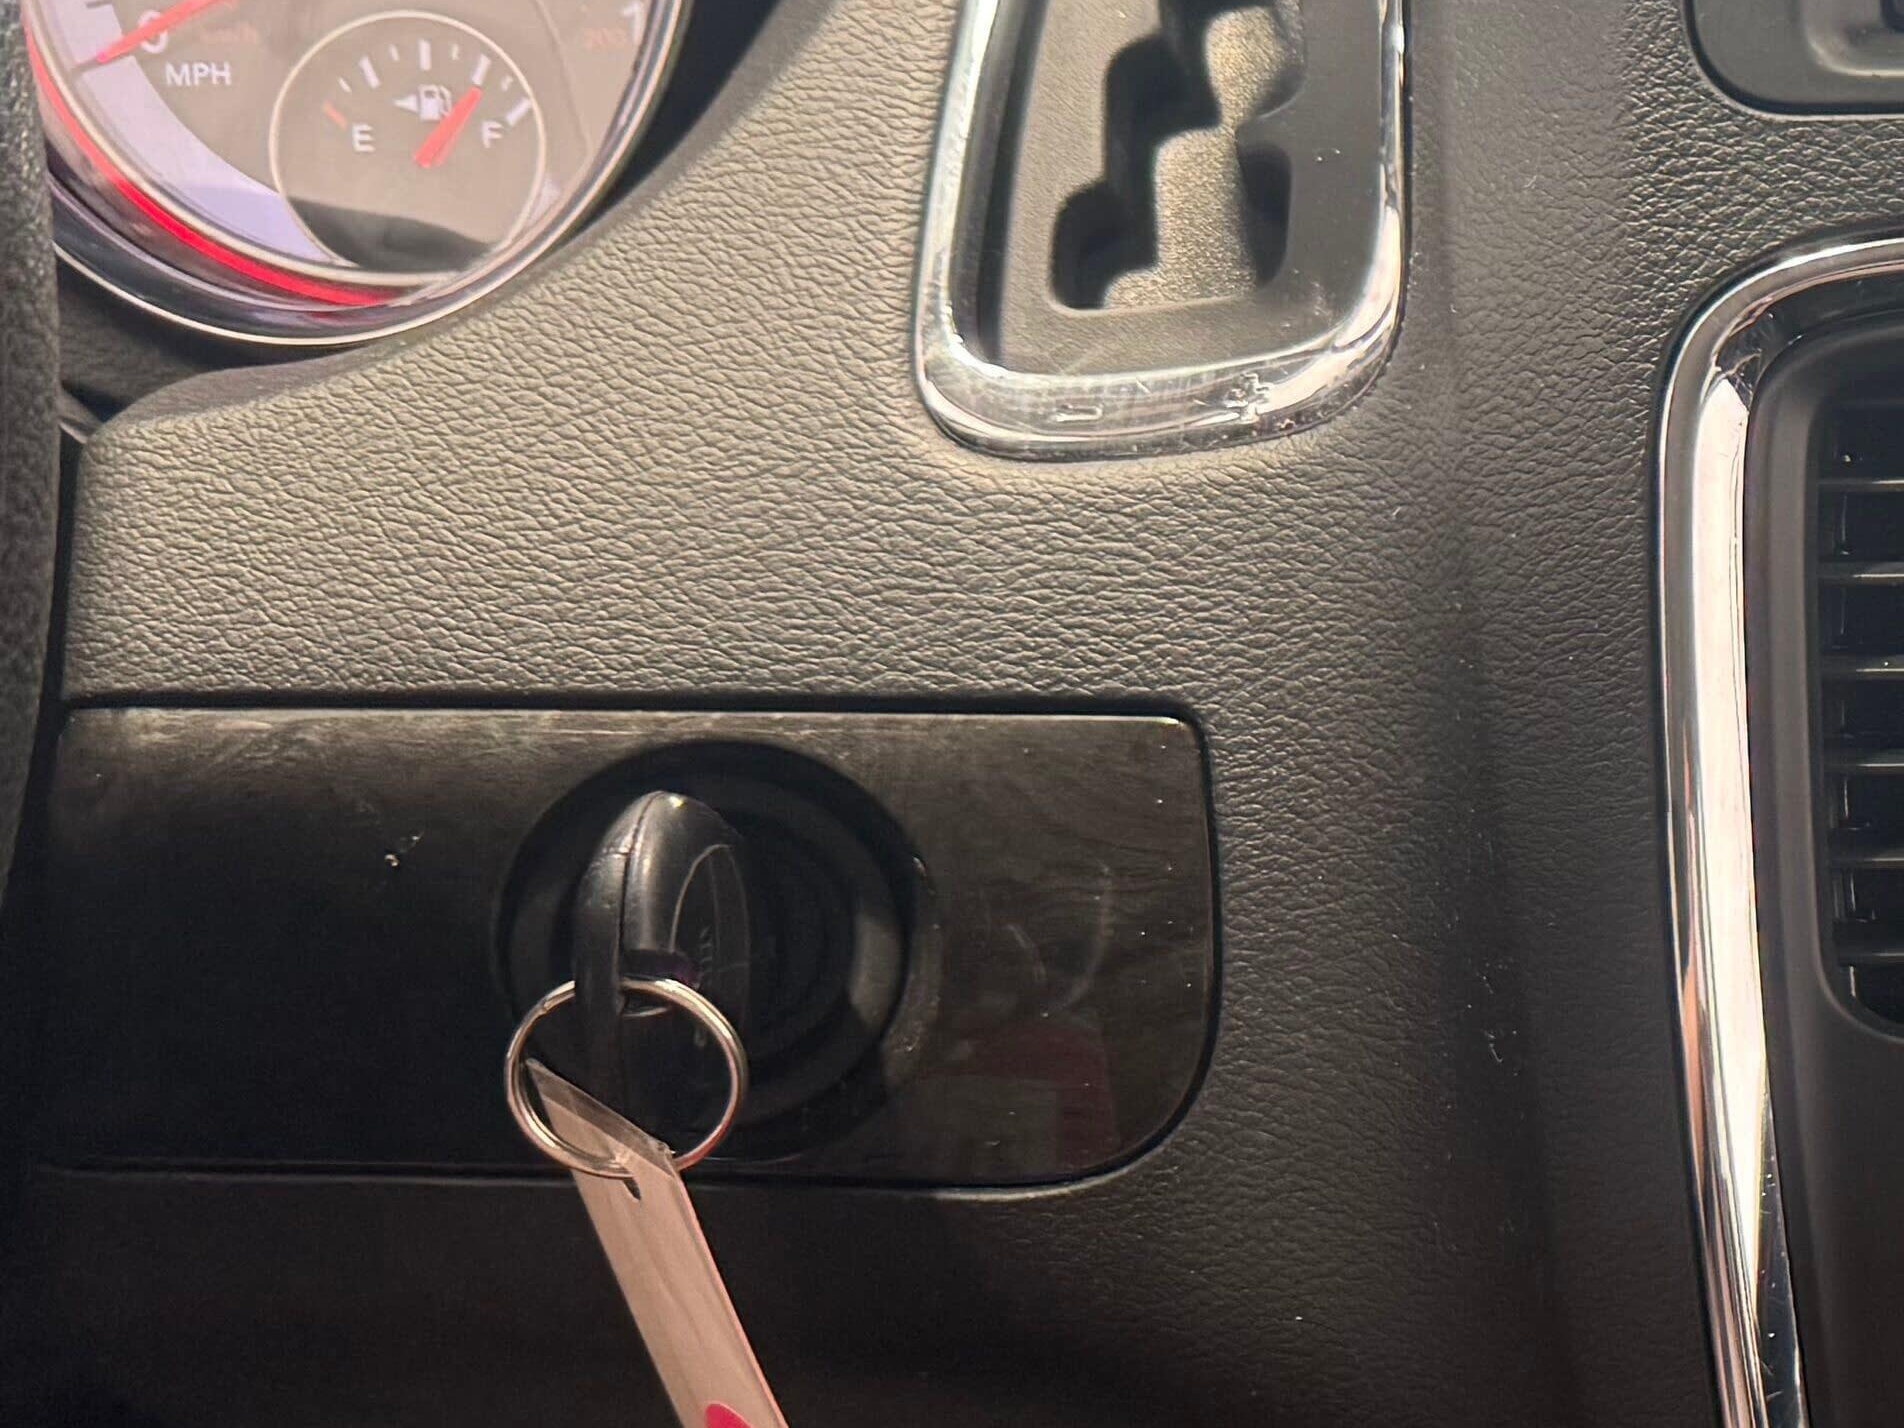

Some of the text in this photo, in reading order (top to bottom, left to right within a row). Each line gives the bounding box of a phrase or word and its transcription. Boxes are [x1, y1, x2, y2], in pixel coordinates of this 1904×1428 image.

[166, 63, 231, 85] MPH
[353, 125, 373, 151] E
[482, 122, 500, 147] F
